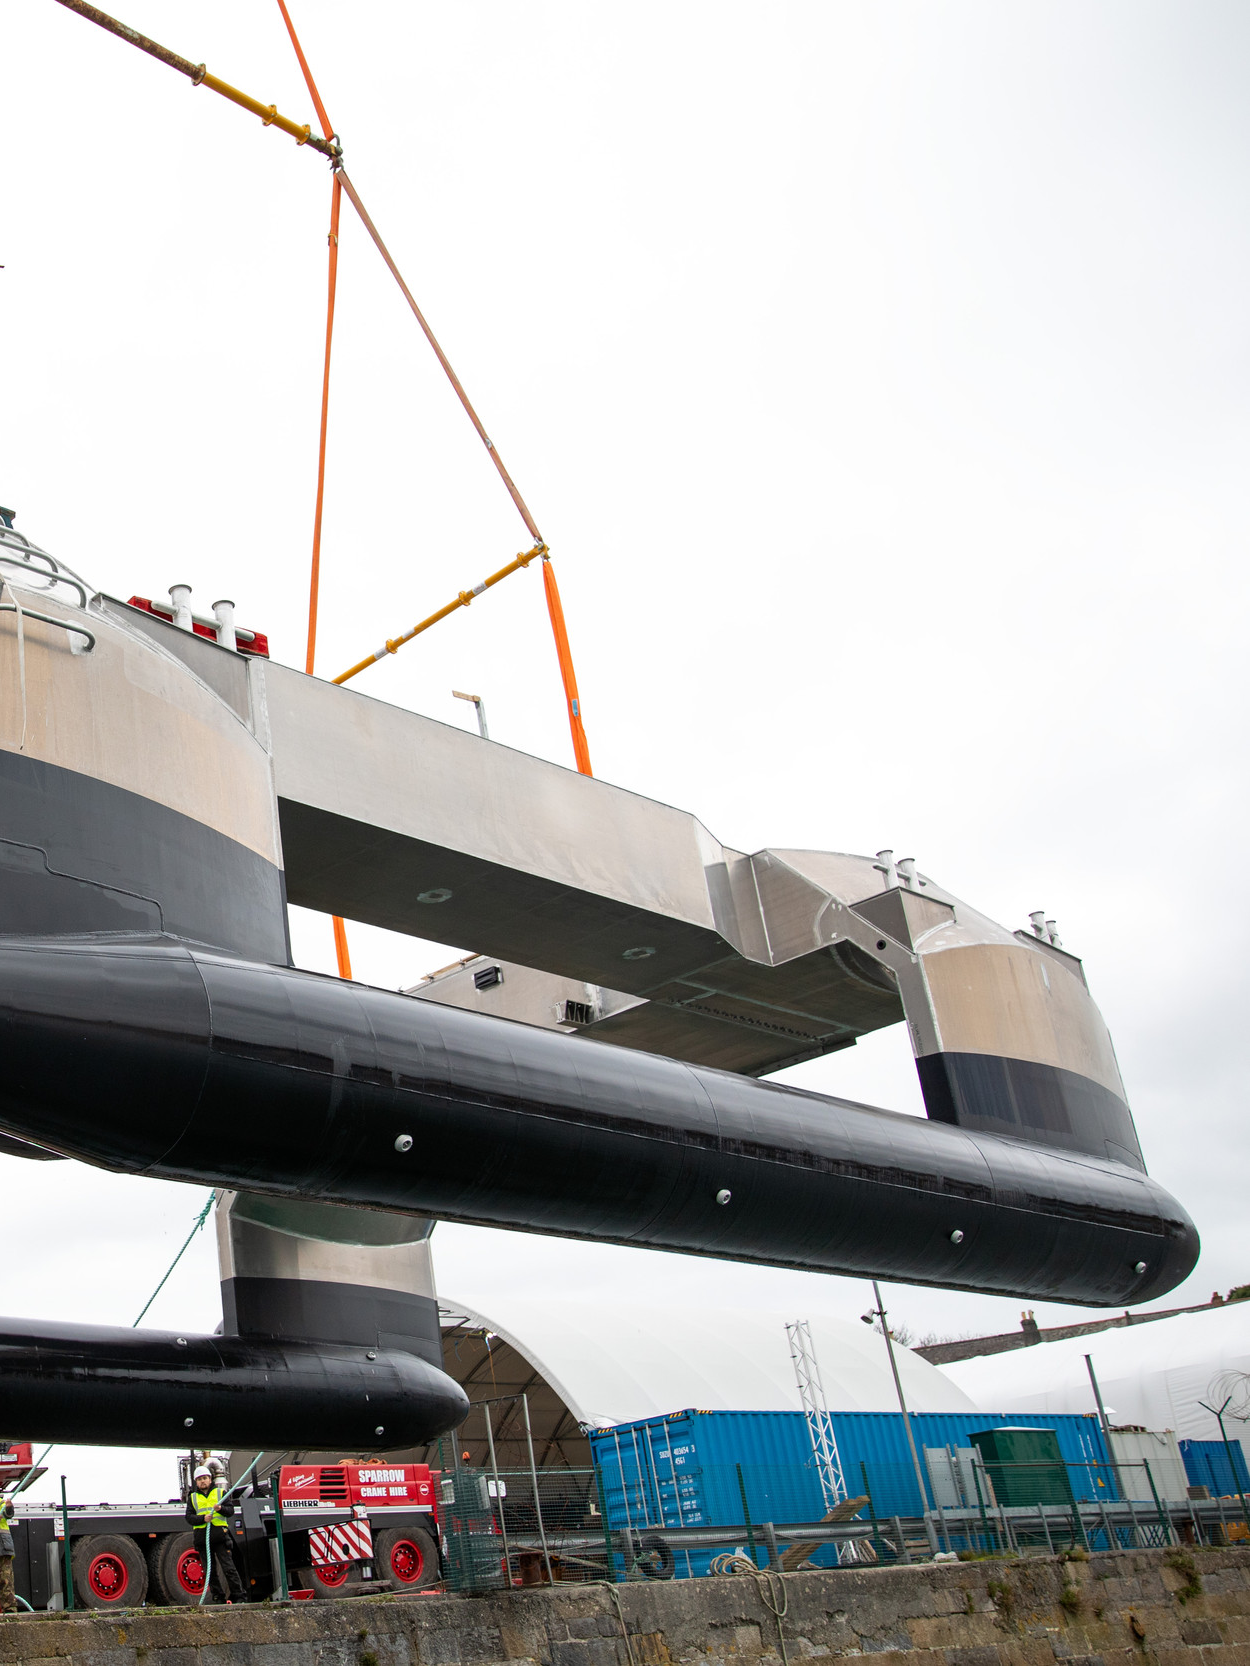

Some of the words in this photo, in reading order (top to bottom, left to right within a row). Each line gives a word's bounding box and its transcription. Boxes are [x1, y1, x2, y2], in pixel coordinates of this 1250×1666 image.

[358, 1469, 405, 1483] SPARROW
[360, 1487, 387, 1497] CRANE
[389, 1486, 408, 1496] HIRE
[283, 1500, 319, 1508] LIEBHERR
